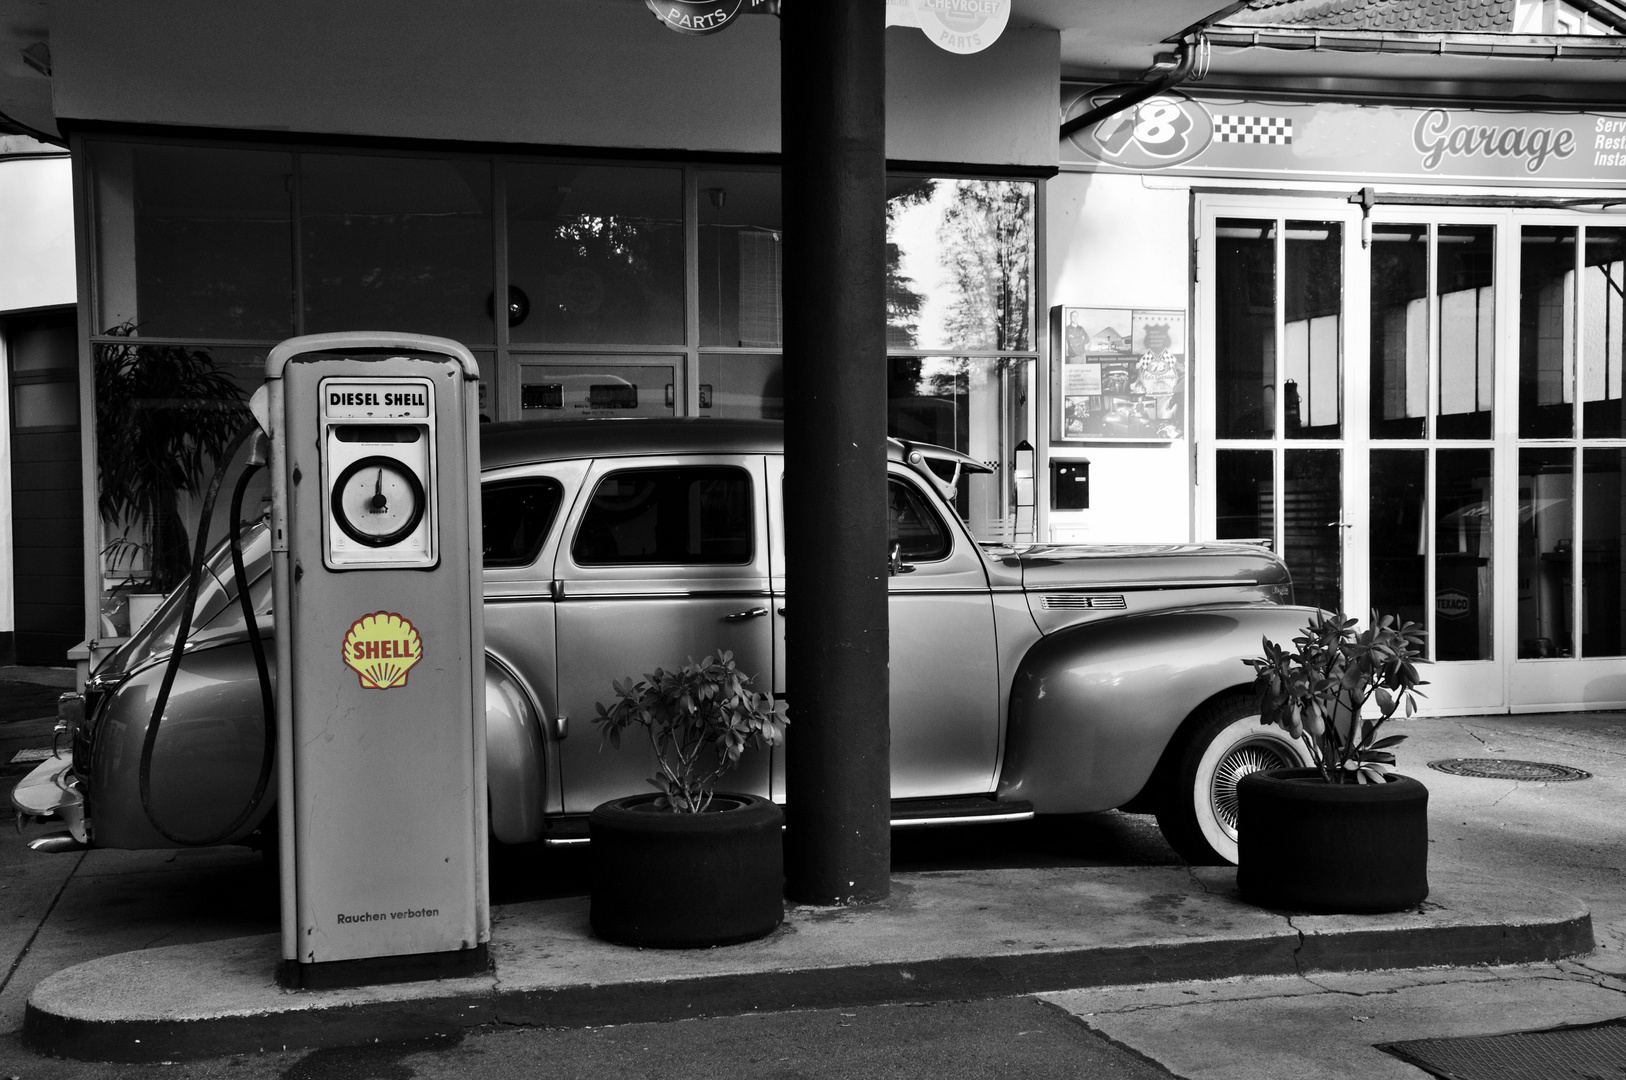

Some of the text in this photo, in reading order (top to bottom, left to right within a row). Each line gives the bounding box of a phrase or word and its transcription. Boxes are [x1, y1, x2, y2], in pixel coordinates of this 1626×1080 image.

[926, 0, 998, 14] CHEVROLET
[667, 7, 728, 29] PARTS
[939, 30, 982, 48] PARTS
[1413, 107, 1577, 174] Garage
[1594, 134, 1626, 149] Rest
[1150, 360, 1167, 373] 78
[330, 392, 425, 406] DIESEL SHELL
[1437, 598, 1468, 610] TEXACO
[353, 639, 415, 660] SHELL
[337, 908, 440, 925] Rauchen verboten
